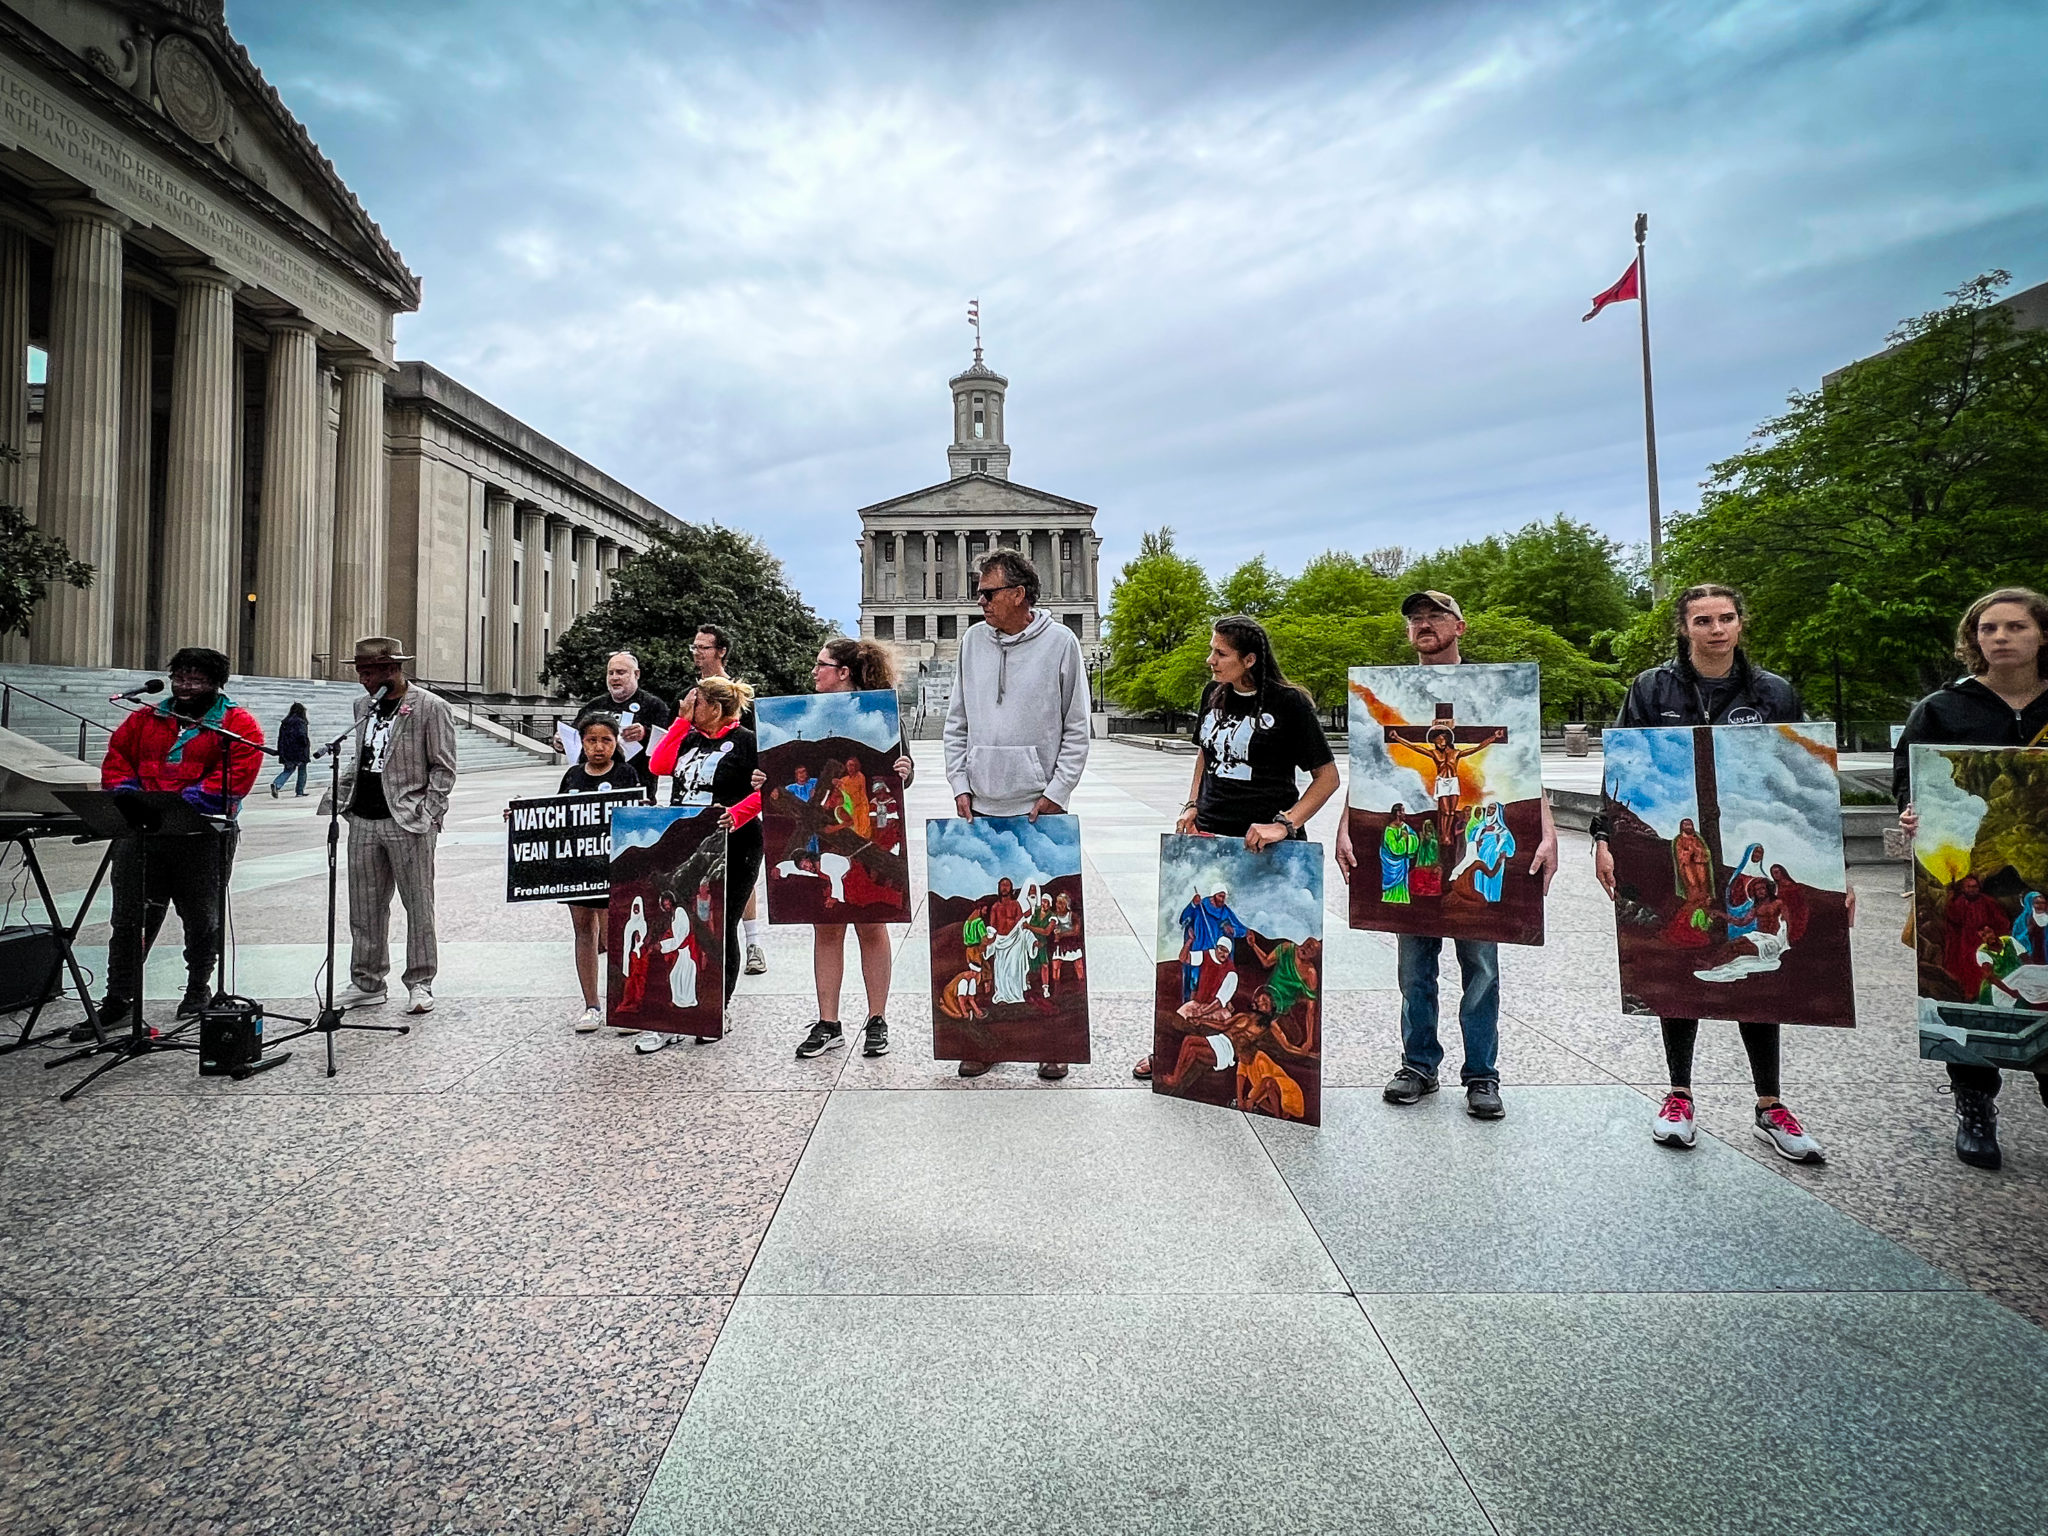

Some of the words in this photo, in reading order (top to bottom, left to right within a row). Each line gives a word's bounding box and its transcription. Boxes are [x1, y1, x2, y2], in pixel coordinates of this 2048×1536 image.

[44, 128, 79, 159] AND
[82, 149, 161, 208] HAPPINESS
[165, 200, 193, 226] AND
[196, 218, 217, 242] THE
[220, 234, 253, 265] PEACE
[57, 111, 78, 137] TO
[81, 128, 132, 170] SPEND
[136, 160, 163, 191] HER
[166, 181, 206, 216] BLOOD
[209, 210, 234, 233] AND
[235, 225, 258, 250] HER
[512, 841, 549, 862] VEAN
[555, 839, 573, 859] LA
[513, 805, 566, 831] WATCH
[570, 802, 601, 826] THE
